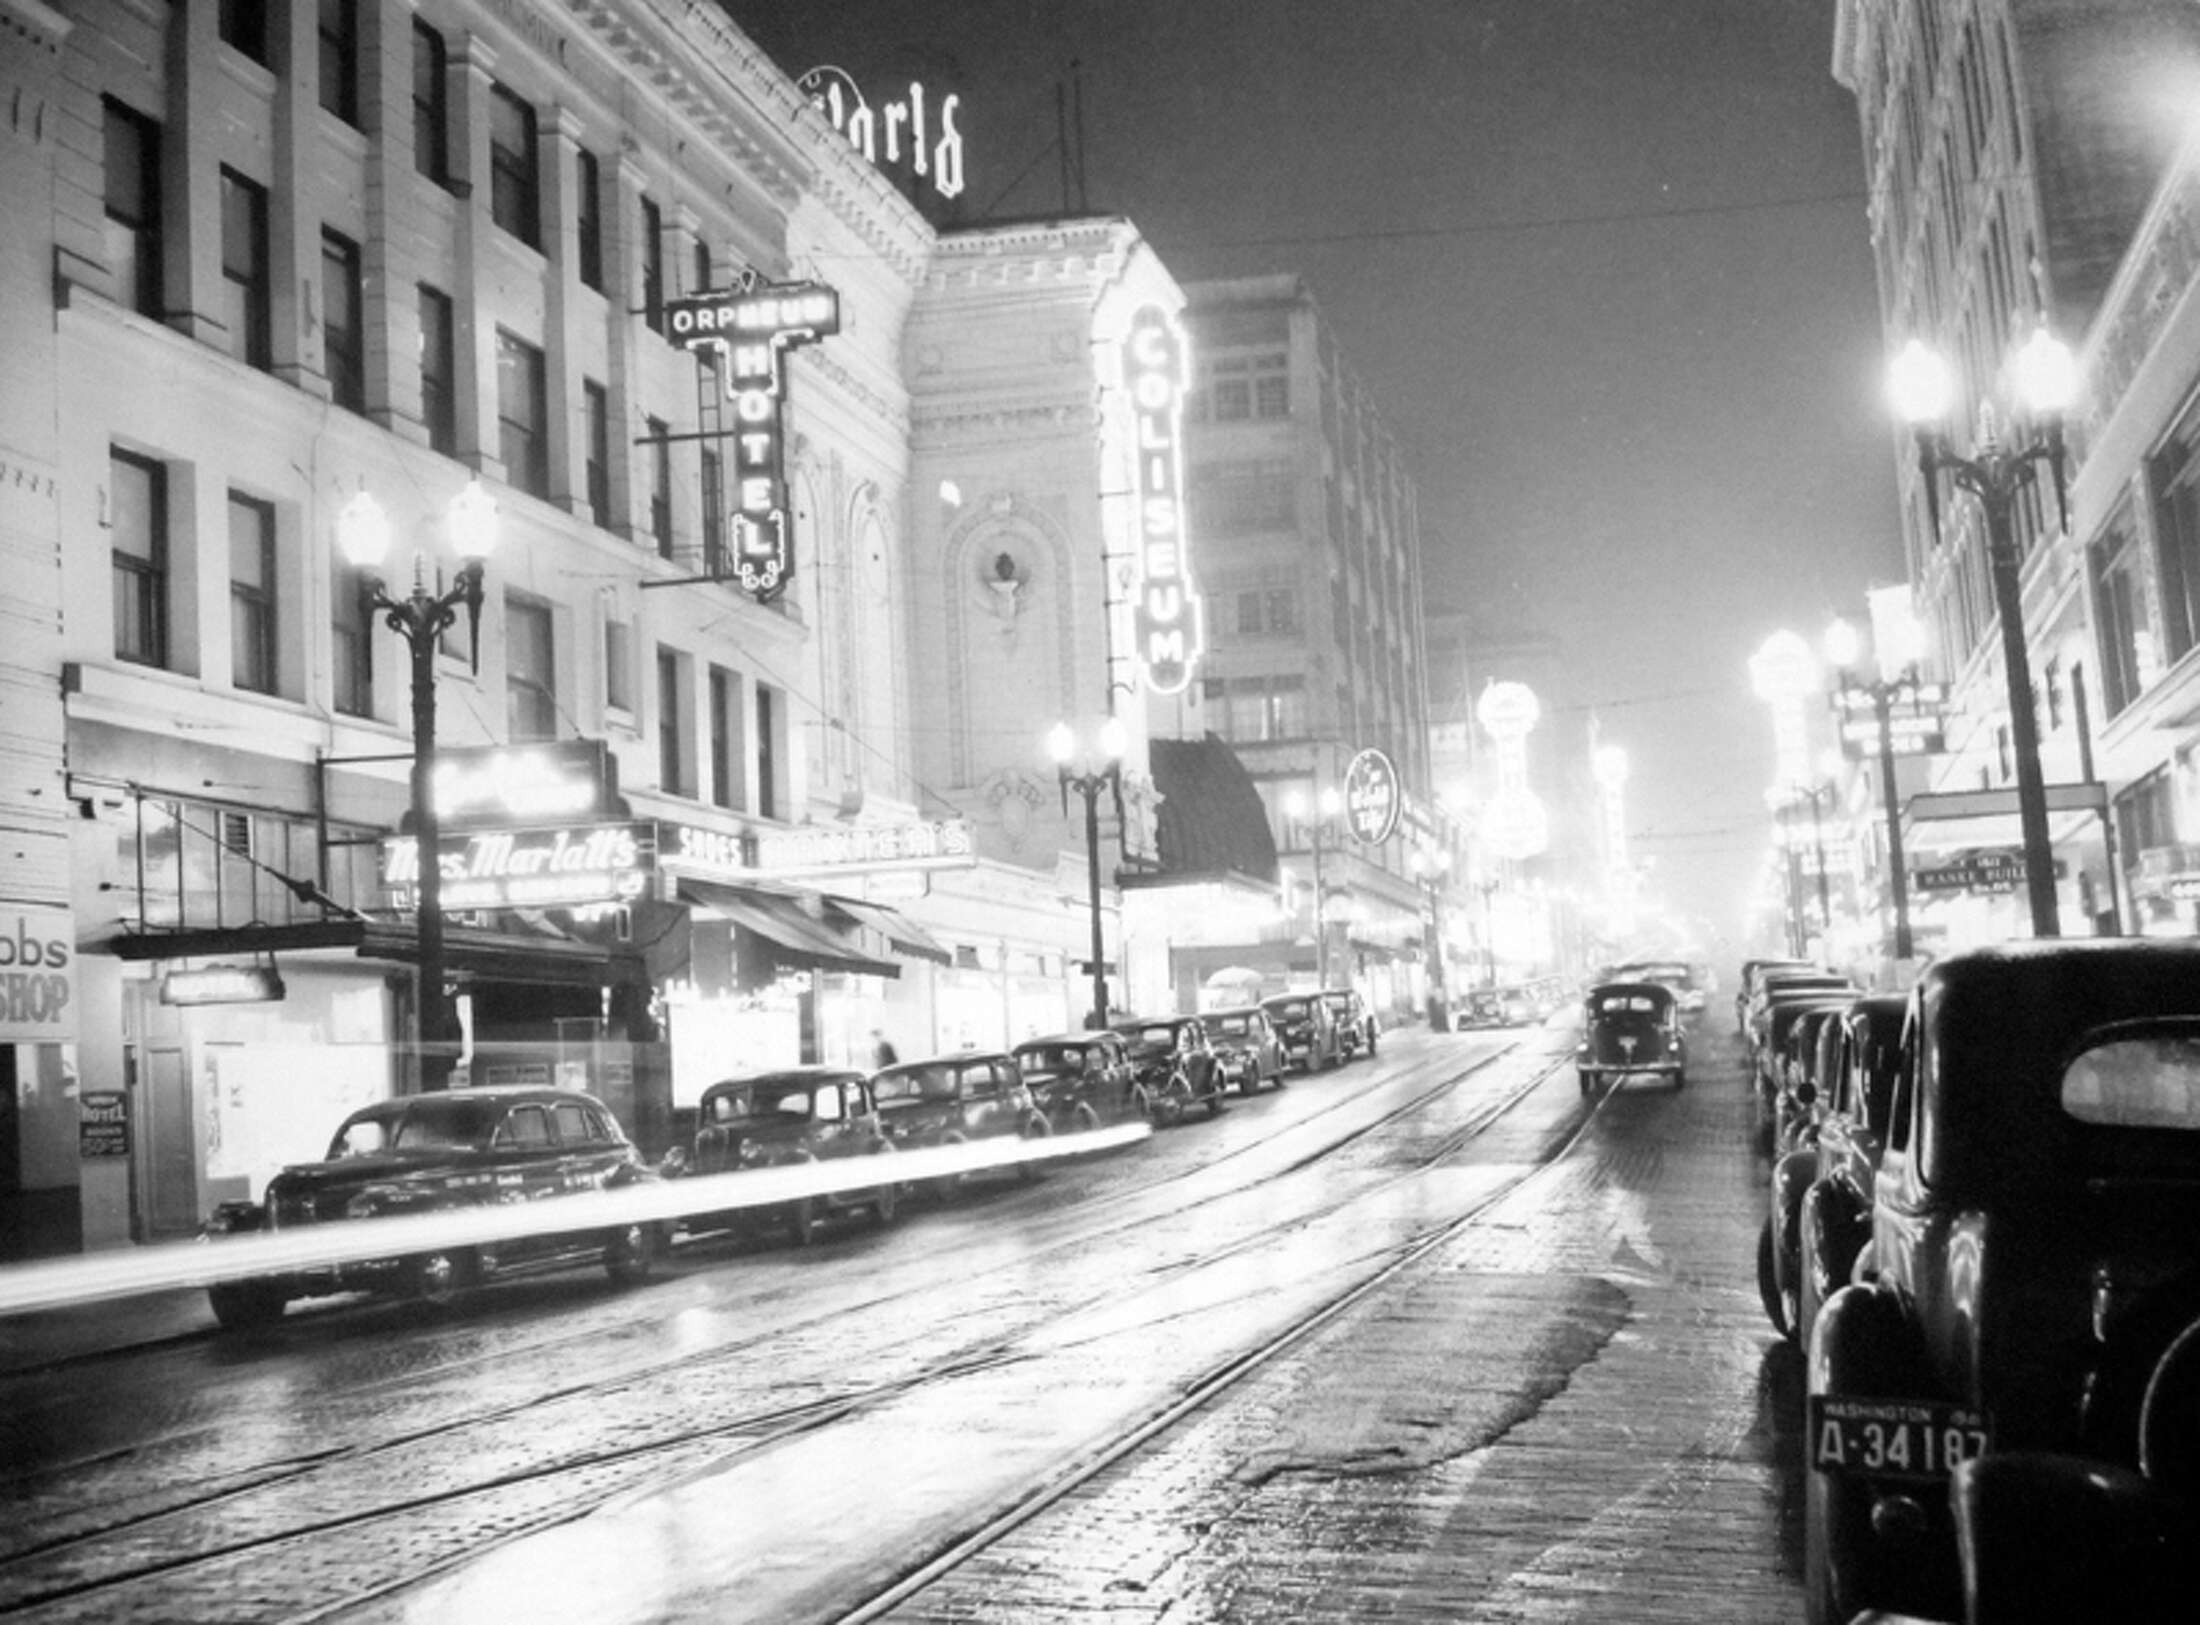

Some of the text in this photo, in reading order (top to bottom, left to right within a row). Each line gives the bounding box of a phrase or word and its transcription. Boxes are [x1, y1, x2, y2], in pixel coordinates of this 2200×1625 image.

[673, 295, 831, 332] ORPHEUM
[735, 345, 772, 555] HOTEL
[1131, 325, 1184, 662] COLISEUM
[385, 836, 469, 882] Ms.
[1823, 1403, 1932, 1422] WASHINGTON
